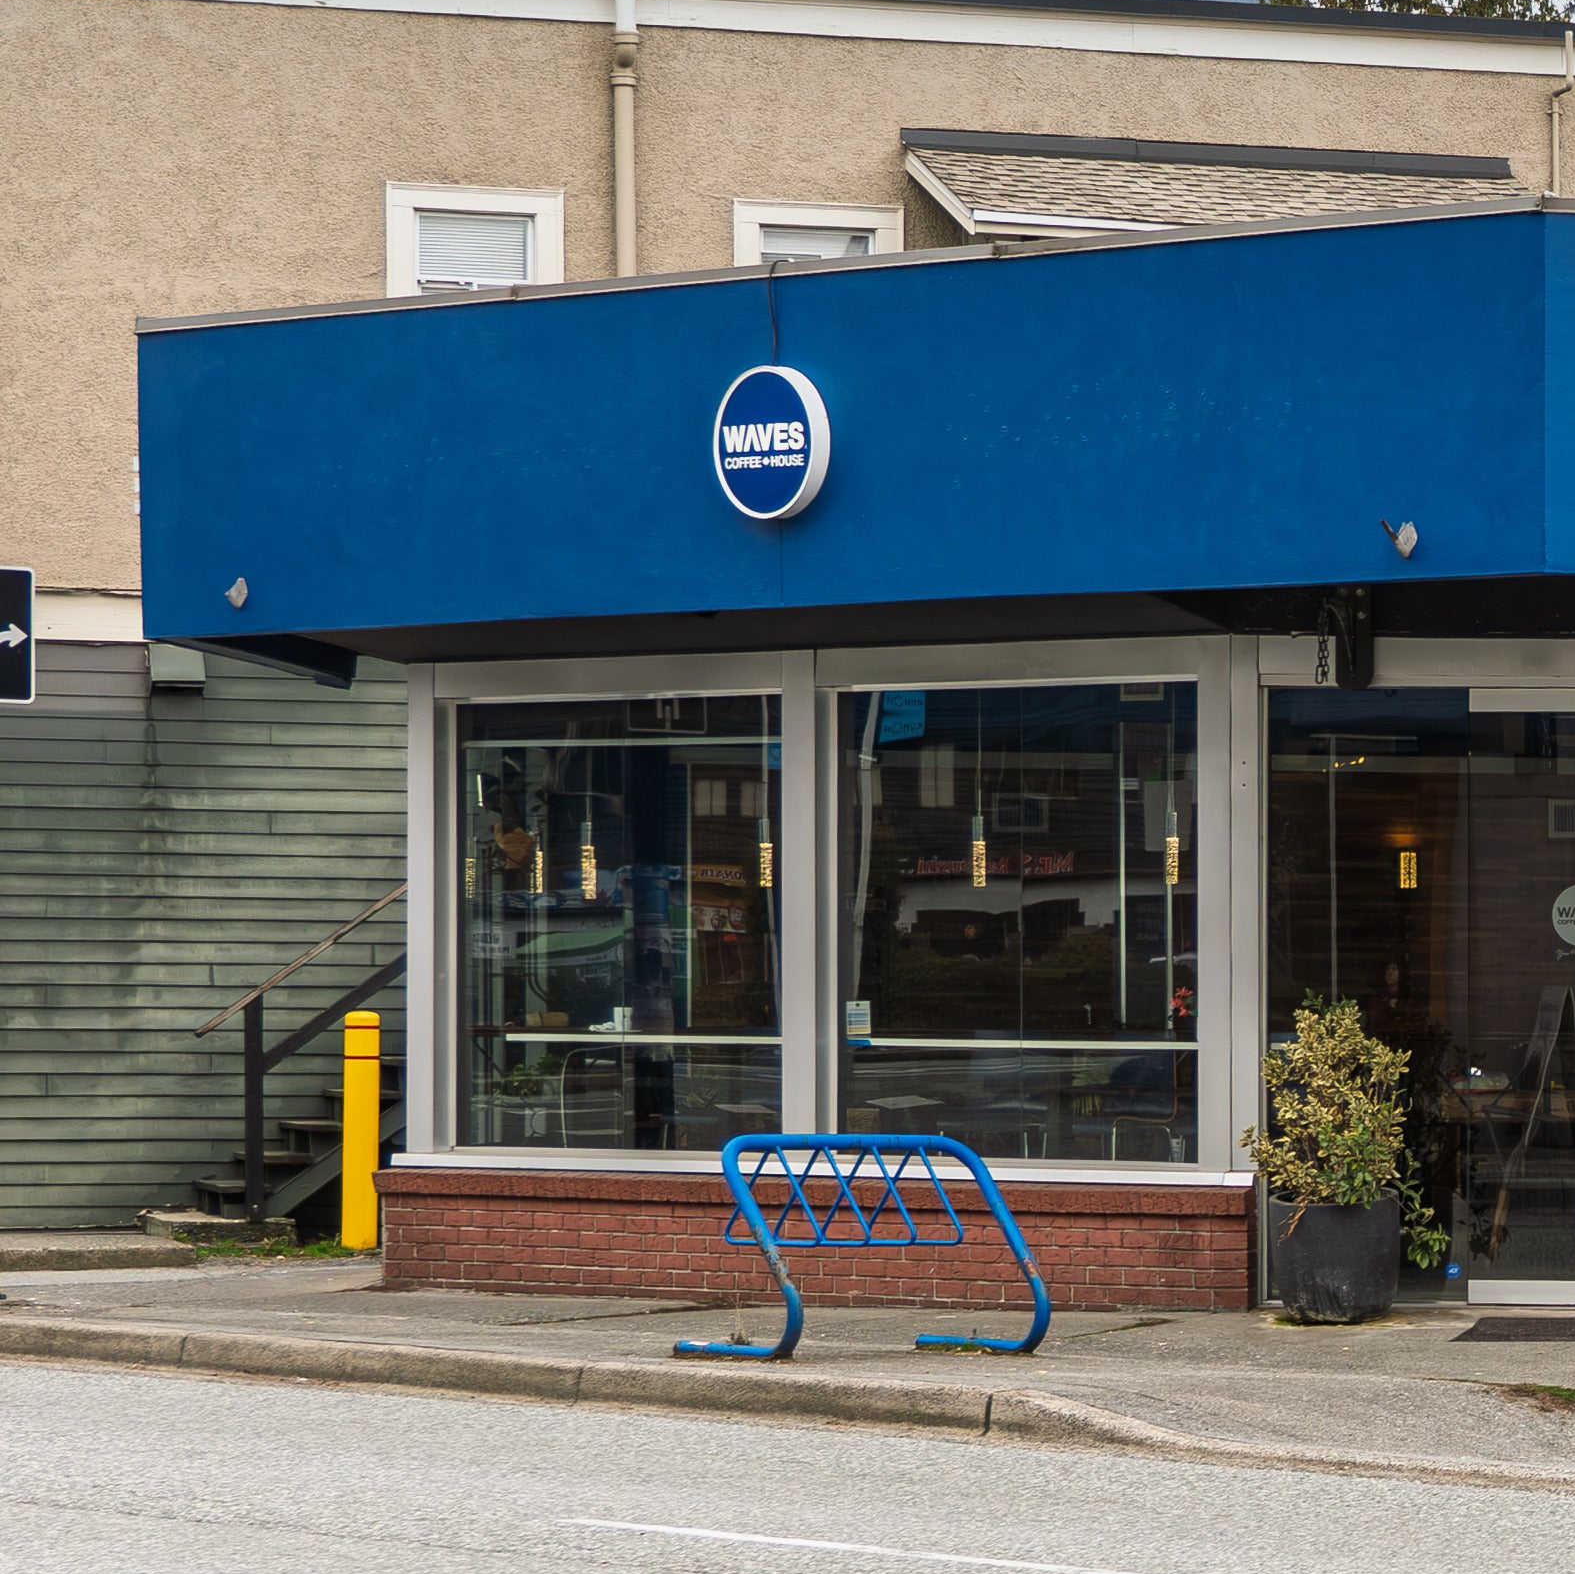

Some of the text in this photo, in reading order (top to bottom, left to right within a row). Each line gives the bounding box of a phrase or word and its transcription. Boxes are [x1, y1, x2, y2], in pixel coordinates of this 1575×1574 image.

[722, 421, 805, 453] WAVES
[725, 454, 805, 469] COFFEE HOUSE
